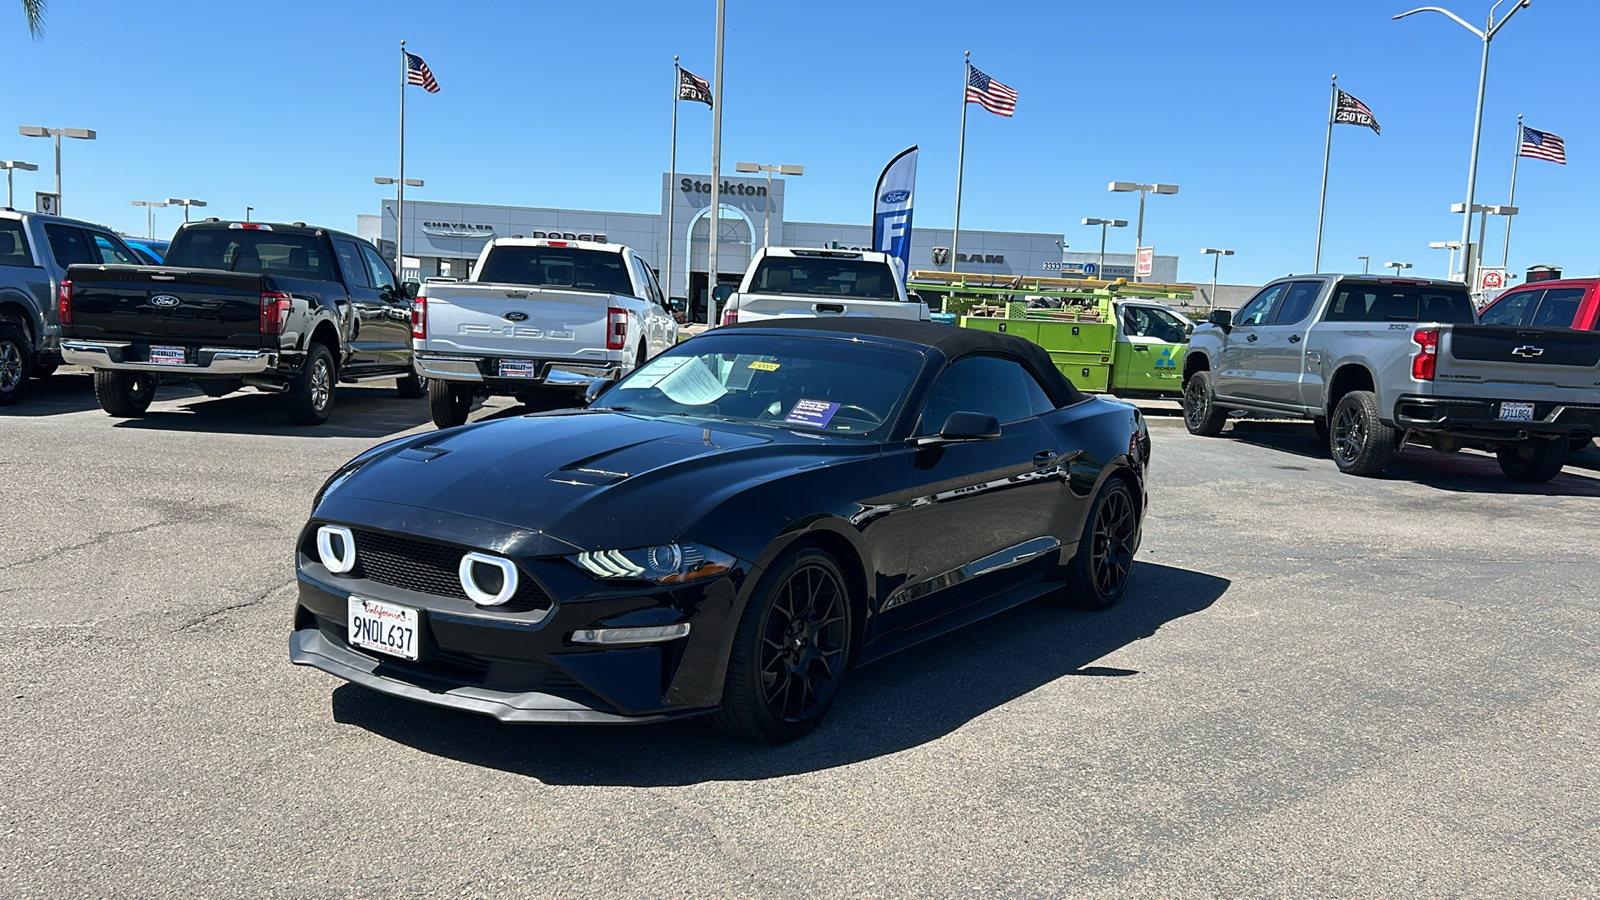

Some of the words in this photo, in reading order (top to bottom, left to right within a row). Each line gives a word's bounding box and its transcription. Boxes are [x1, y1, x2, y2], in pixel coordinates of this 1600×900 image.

[680, 88, 696, 98] 250
[1336, 111, 1356, 122] 250
[423, 222, 494, 230] CHRYSLER
[533, 231, 606, 242] DODGE
[956, 253, 1004, 264] RAM
[1044, 262, 1061, 270] 3333
[458, 324, 576, 340] F-150
[364, 602, 403, 620] California
[353, 616, 413, 652] 9NOL637
